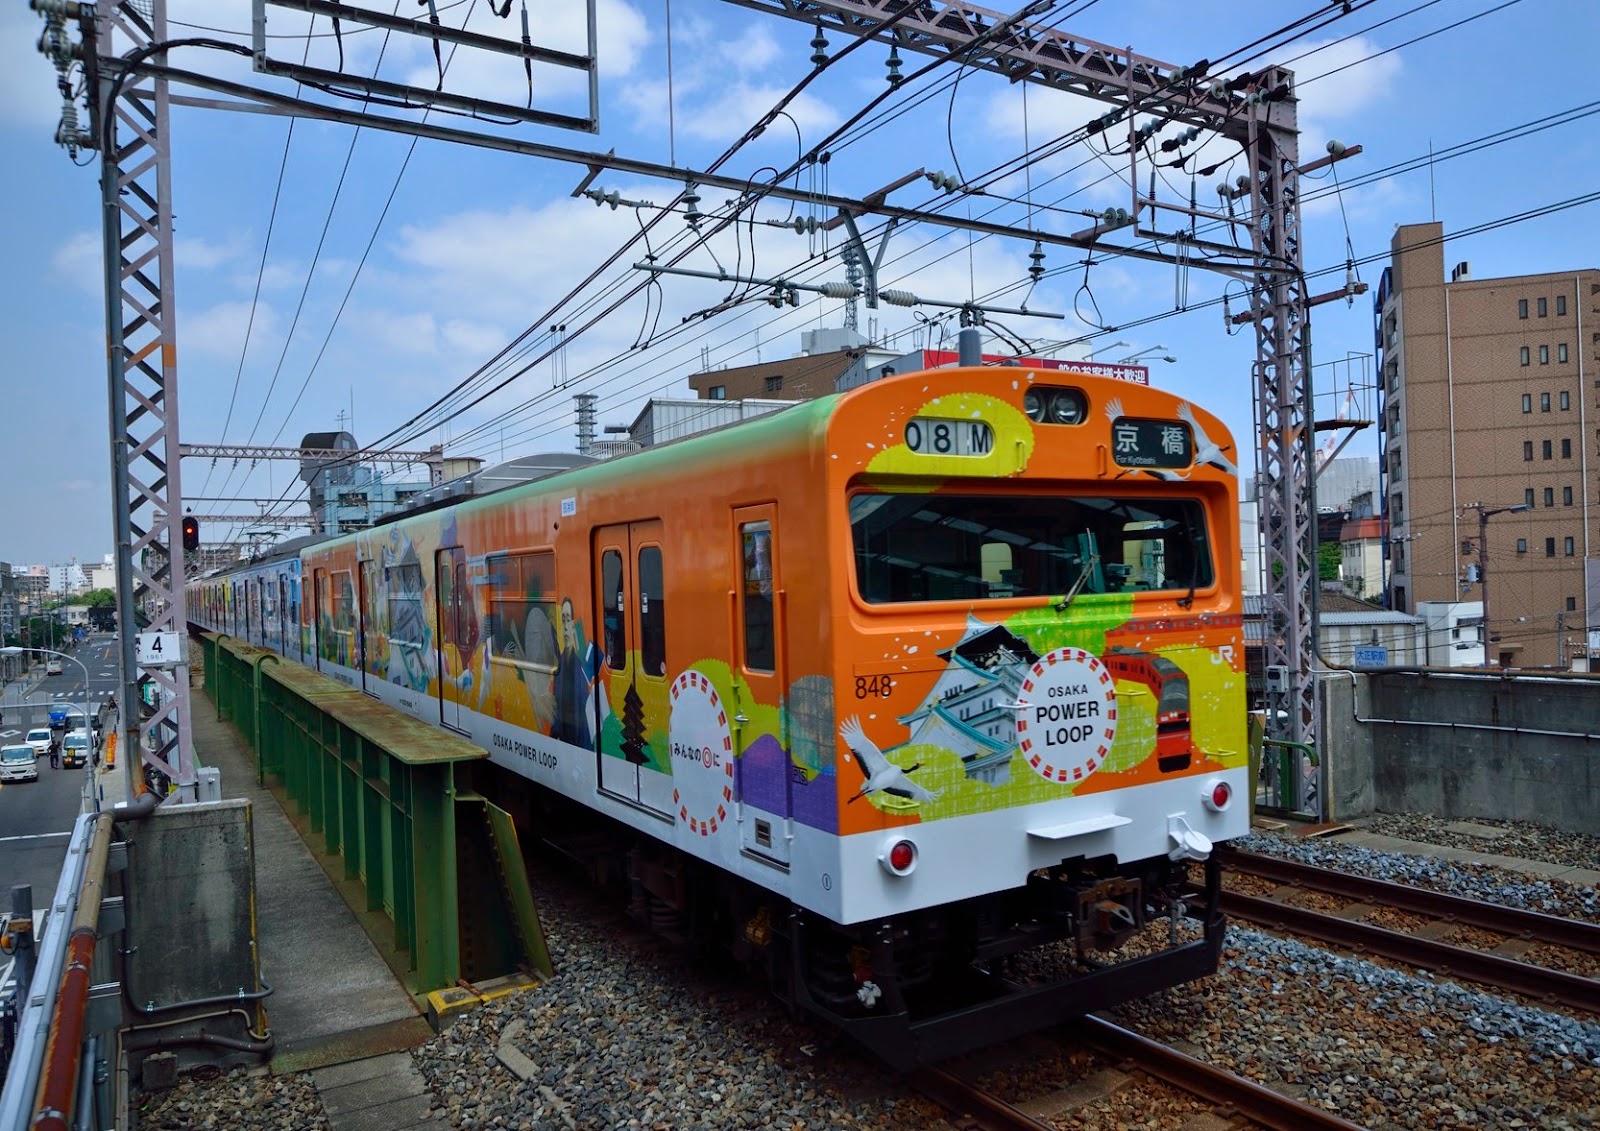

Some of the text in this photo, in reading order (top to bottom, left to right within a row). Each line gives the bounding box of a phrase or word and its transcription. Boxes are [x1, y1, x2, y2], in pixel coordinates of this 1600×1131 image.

[1115, 424, 1184, 455] 京橋
[1116, 455, 1128, 463] For
[152, 636, 163, 653] 4
[1210, 645, 1233, 665] JR
[855, 675, 892, 699] 848
[1047, 684, 1088, 698] OSAKA
[1036, 700, 1099, 723] POWER
[1046, 724, 1093, 746] LOOP
[493, 733, 558, 770] OSAKA POWER LOOP
